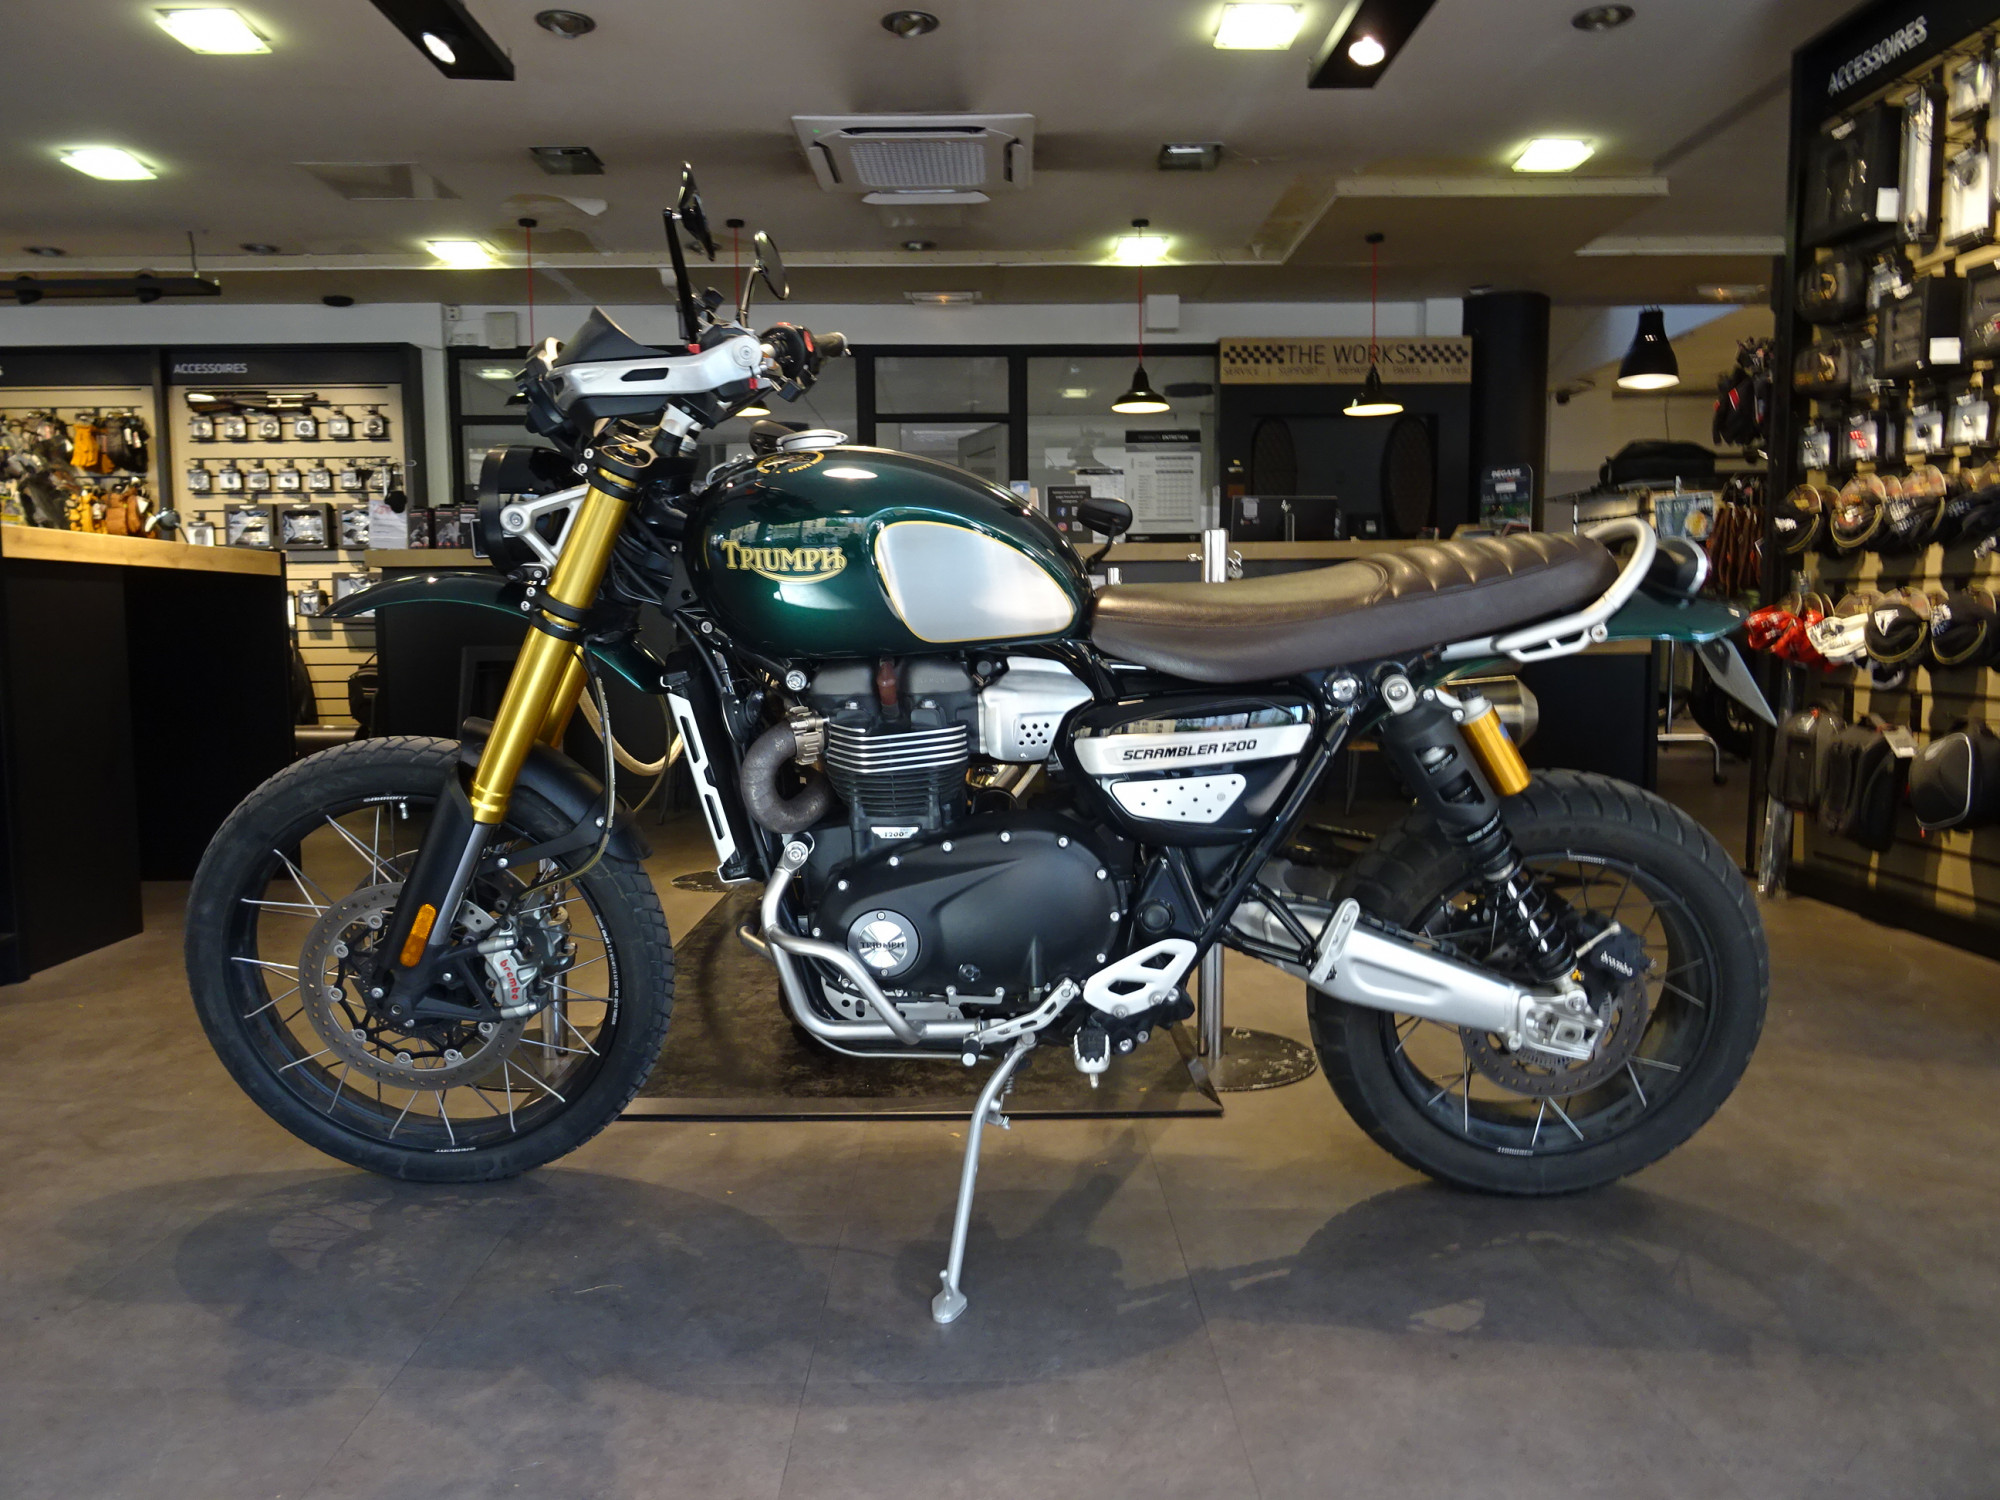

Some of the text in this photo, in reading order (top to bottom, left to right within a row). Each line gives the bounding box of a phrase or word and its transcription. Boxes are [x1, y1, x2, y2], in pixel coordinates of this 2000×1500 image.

[1827, 15, 1928, 97] ACCESSOIRES
[1285, 344, 1407, 364] THE WORKS
[173, 363, 249, 374] ACCESSOIRES
[720, 540, 848, 582] TRIUMPH
[1122, 738, 1258, 761] SCRAMBLER 1200
[859, 941, 906, 949] TRIUMPH
[500, 958, 521, 1001] brembo
